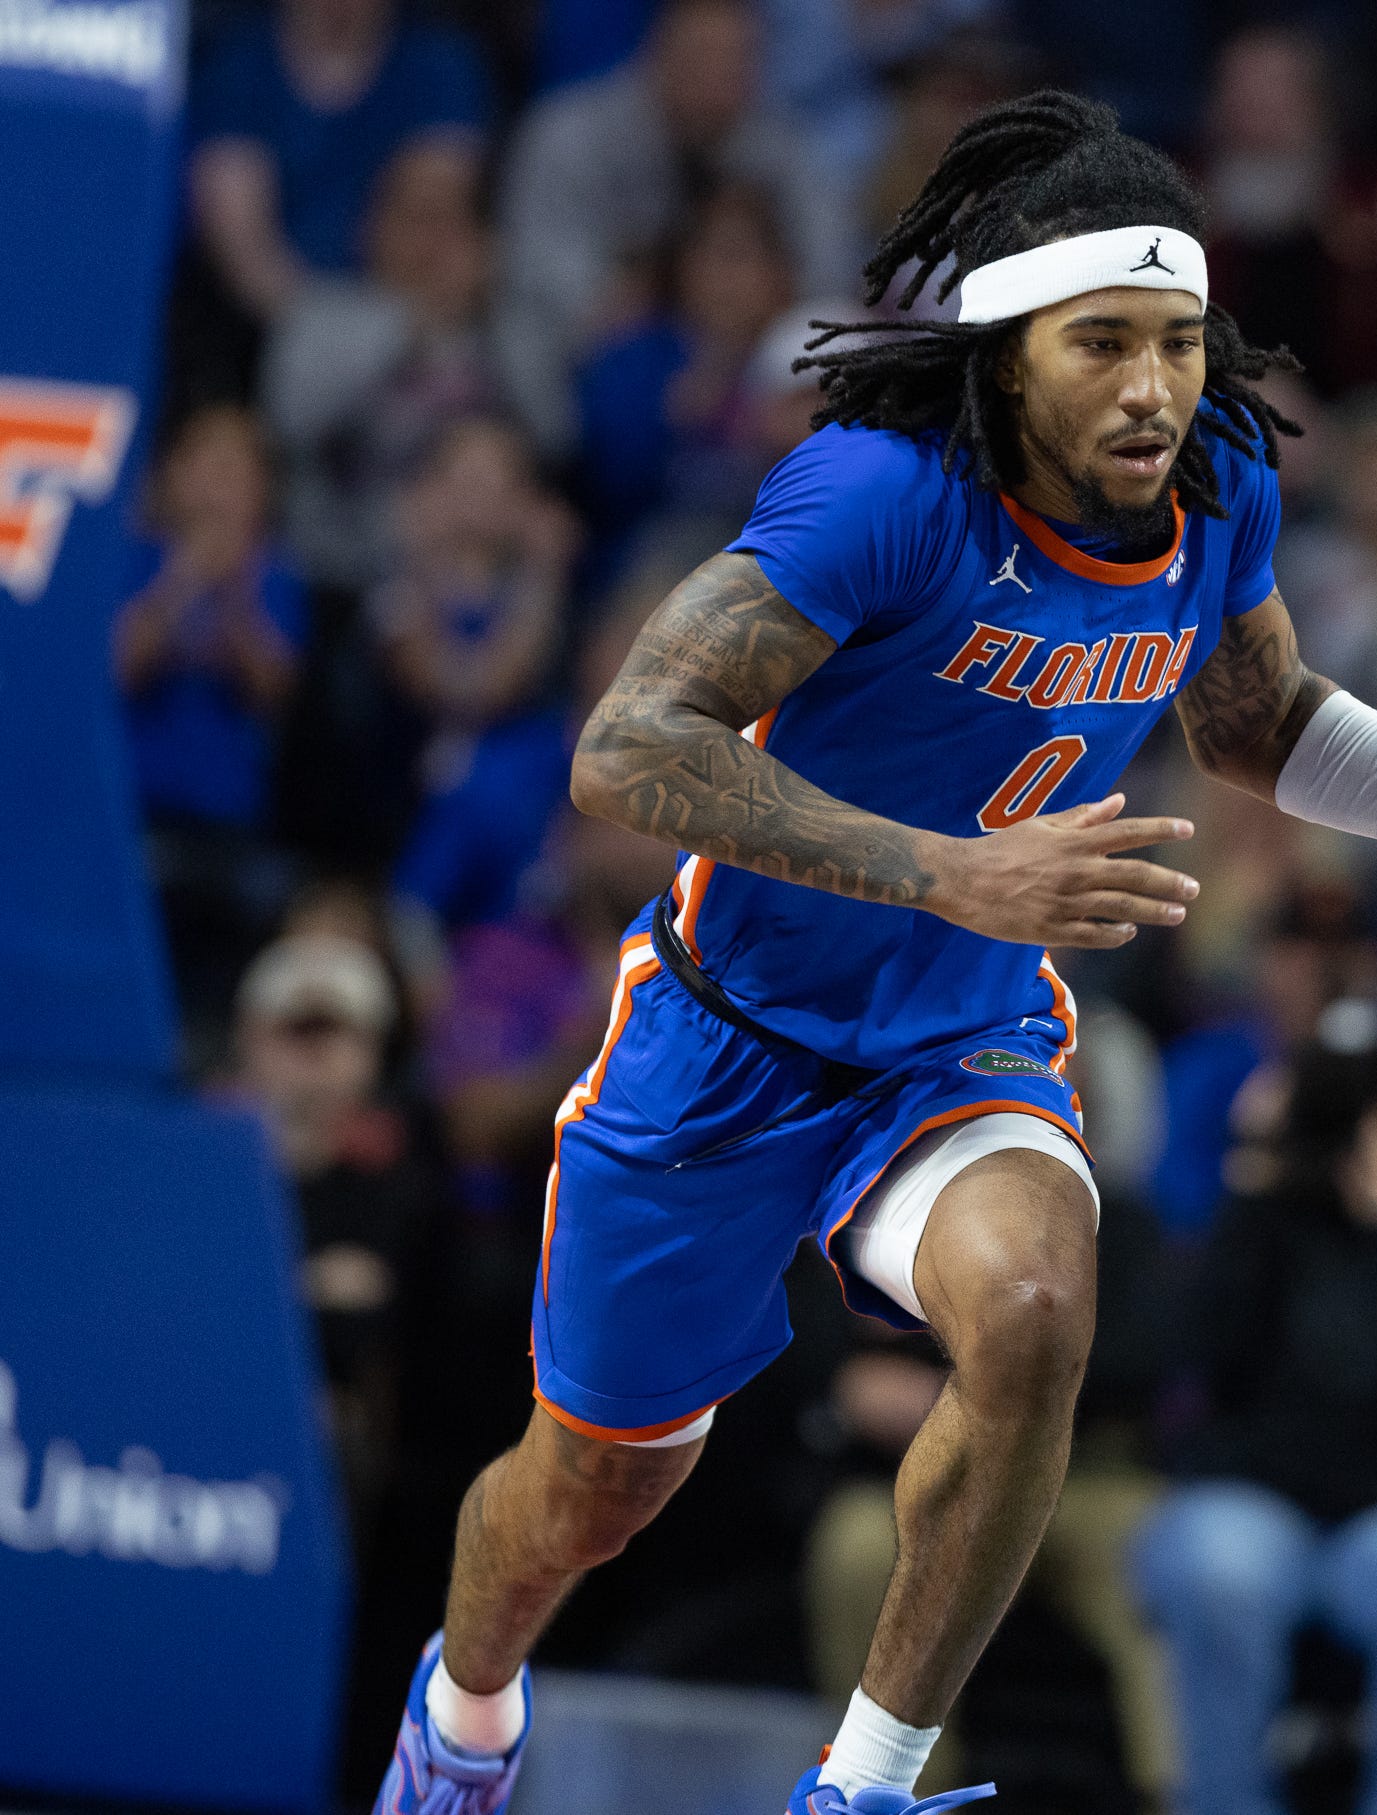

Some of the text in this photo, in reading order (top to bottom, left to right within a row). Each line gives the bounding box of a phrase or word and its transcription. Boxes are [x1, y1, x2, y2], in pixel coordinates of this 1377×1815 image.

[671, 645, 714, 674] ALONE
[933, 620, 1198, 709] FLORIDA
[976, 734, 1087, 832] 0
